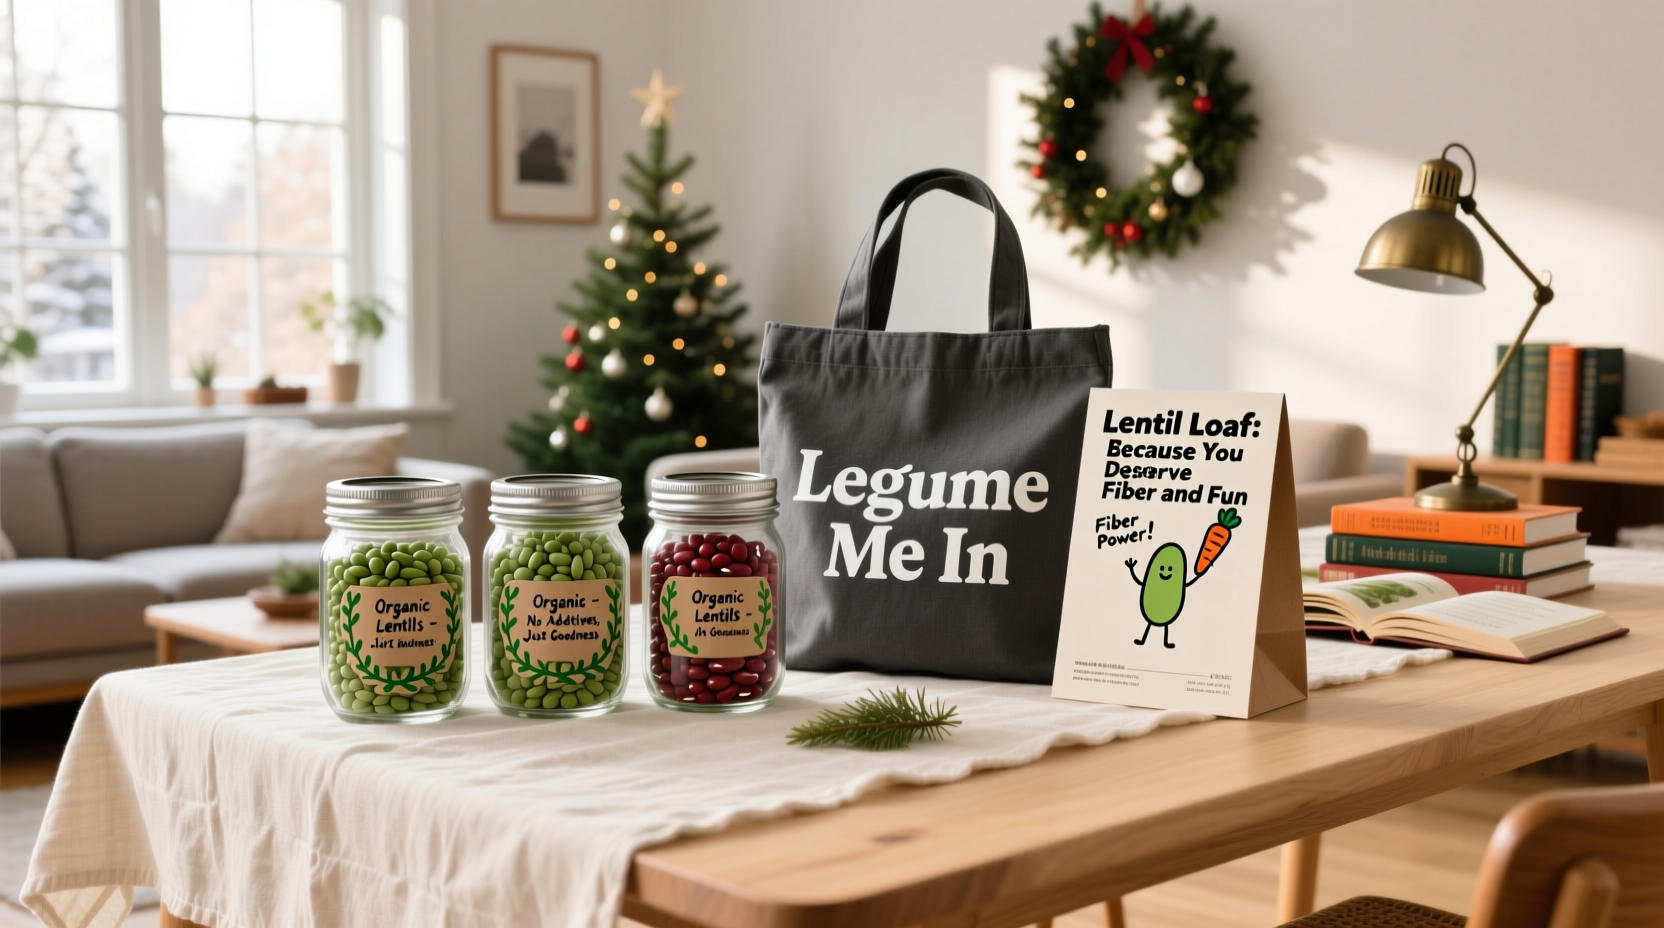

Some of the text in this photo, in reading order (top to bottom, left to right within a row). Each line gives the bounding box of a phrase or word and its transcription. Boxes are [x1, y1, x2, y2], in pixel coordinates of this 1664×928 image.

[1103, 409, 1261, 438] Lentil Loaf:
[1106, 439, 1244, 462] Because You
[793, 449, 1049, 523] Legume
[1101, 481, 1248, 506] Fiber and Fun
[1095, 513, 1139, 533] Fiber
[823, 522, 1009, 585] Me In
[375, 598, 430, 619] Organic
[533, 593, 586, 614] Organic
[692, 589, 744, 609] Organic
[526, 614, 542, 627] No
[695, 607, 740, 623] Lentils
